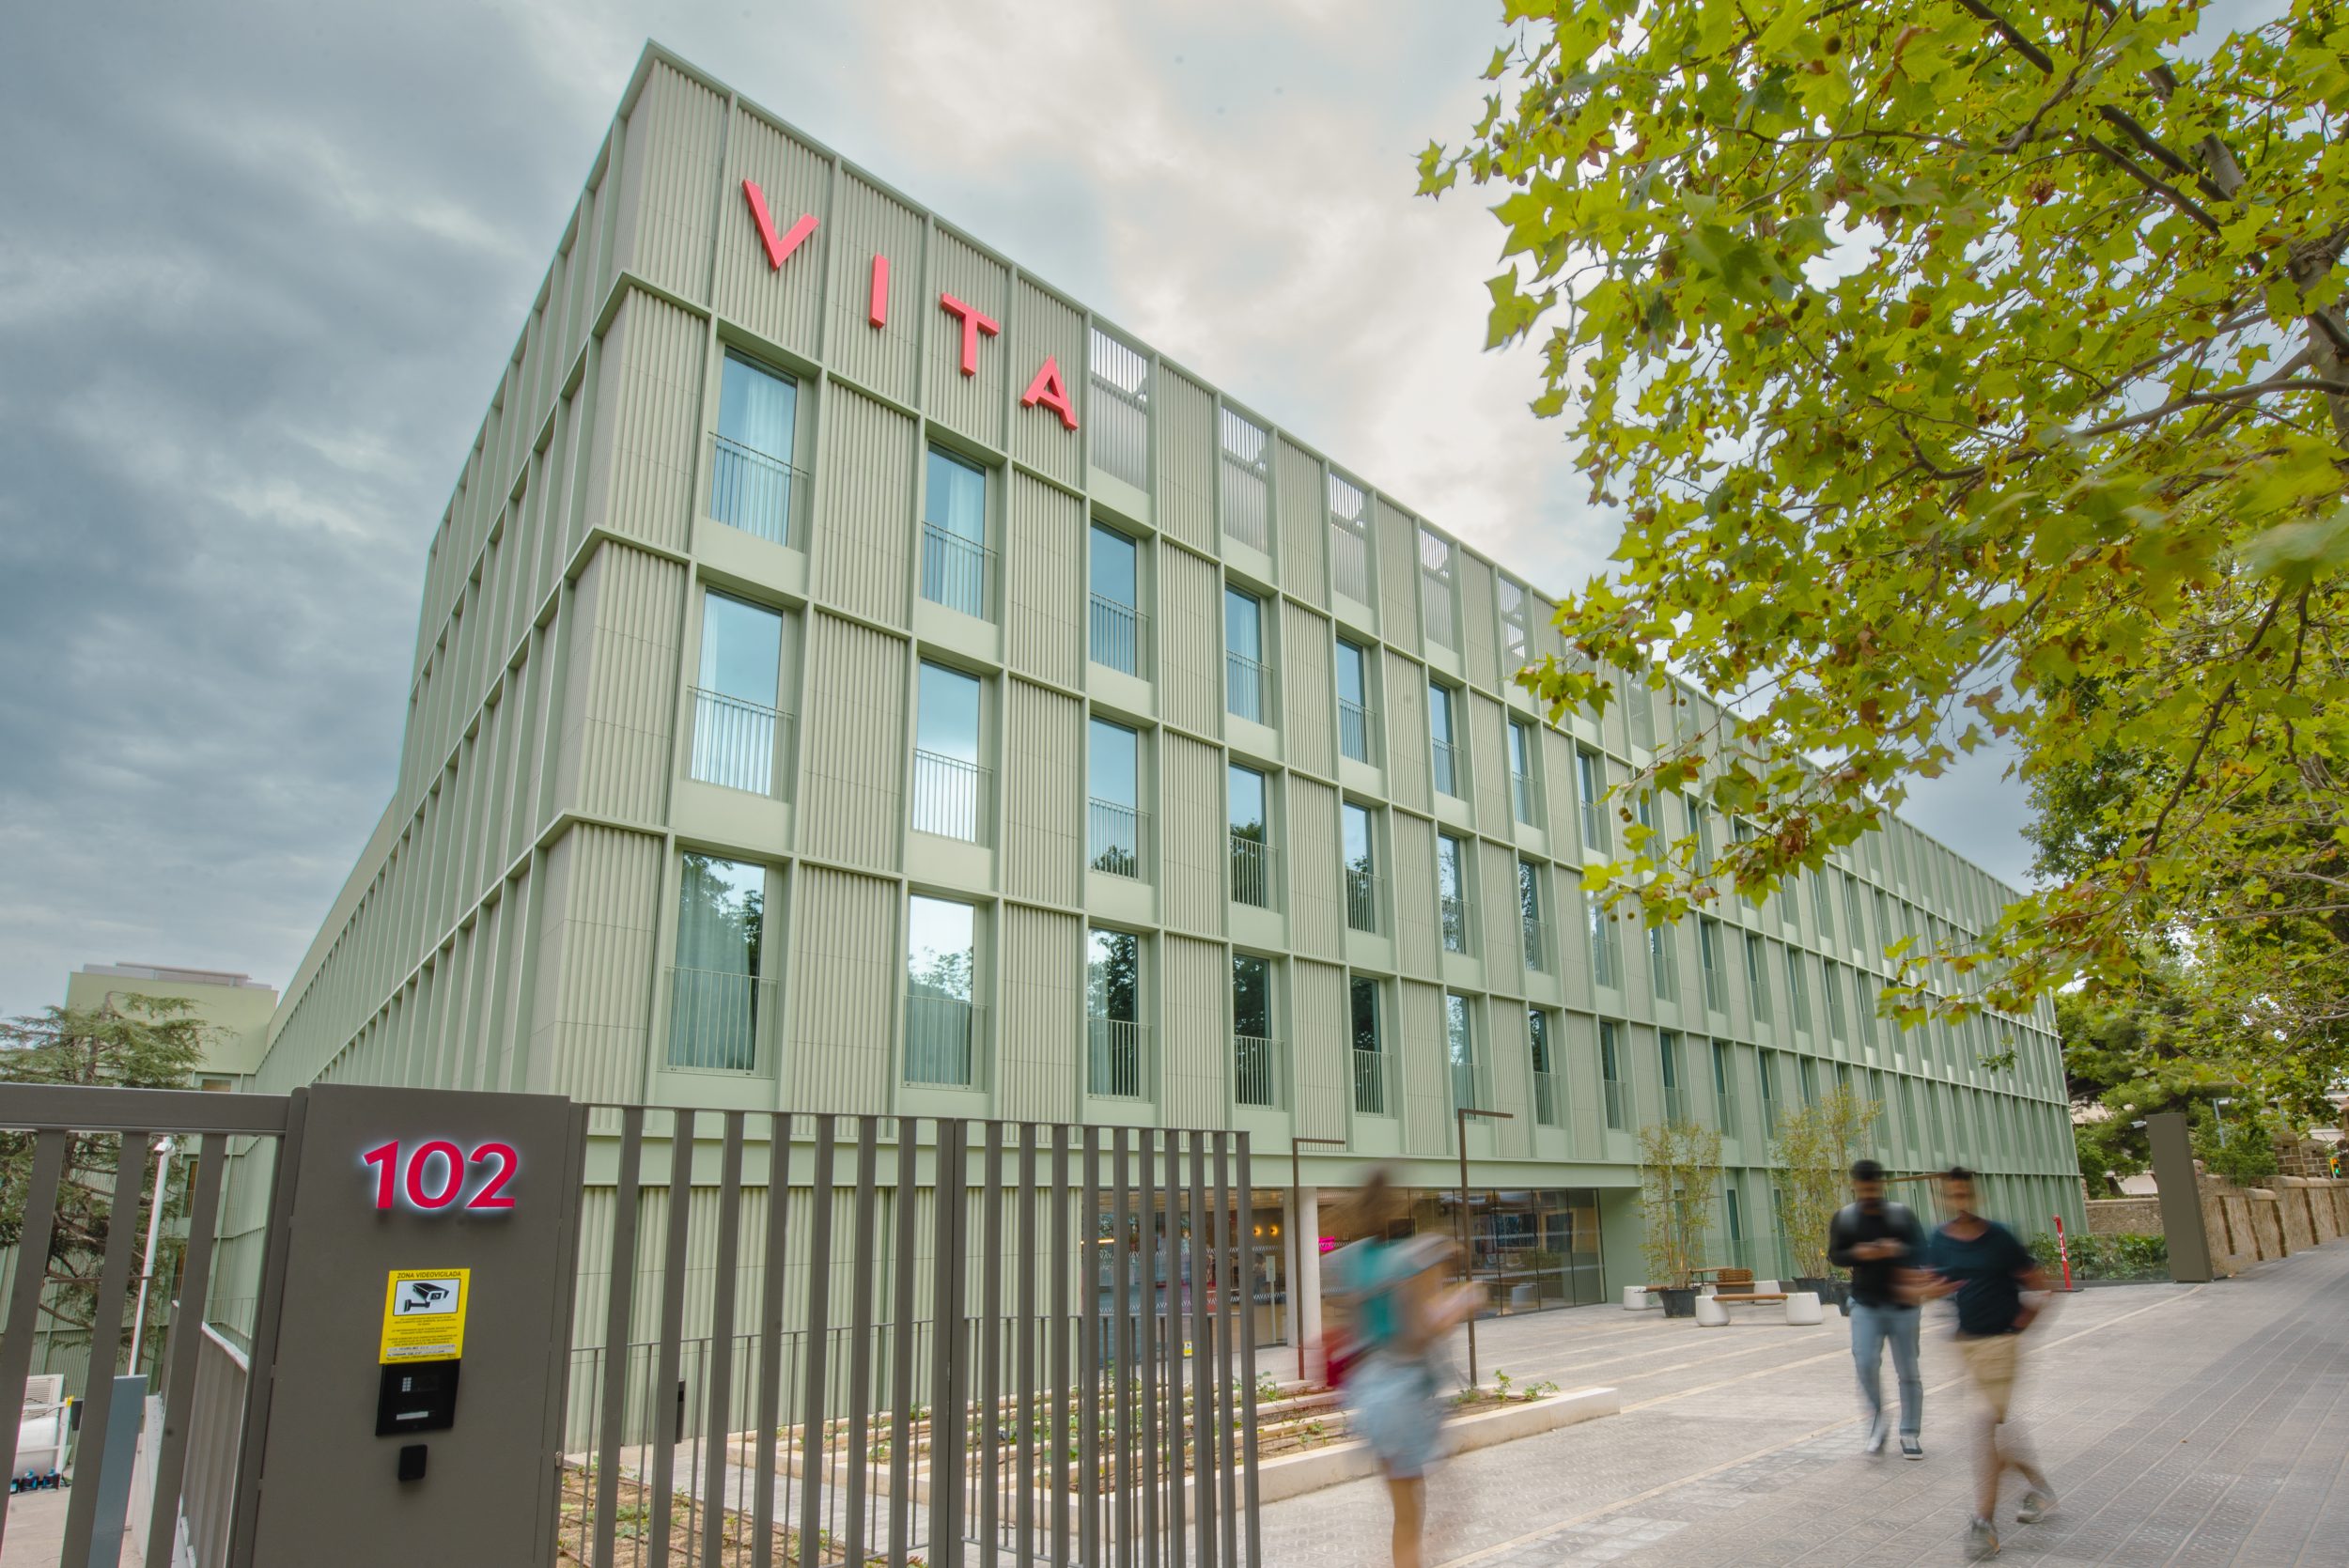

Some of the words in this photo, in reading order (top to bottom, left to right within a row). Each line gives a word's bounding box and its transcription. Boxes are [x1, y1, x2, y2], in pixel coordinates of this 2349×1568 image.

[741, 178, 1079, 432] VITA
[362, 1139, 518, 1209] 102
[2057, 1232, 2067, 1262] VITA
